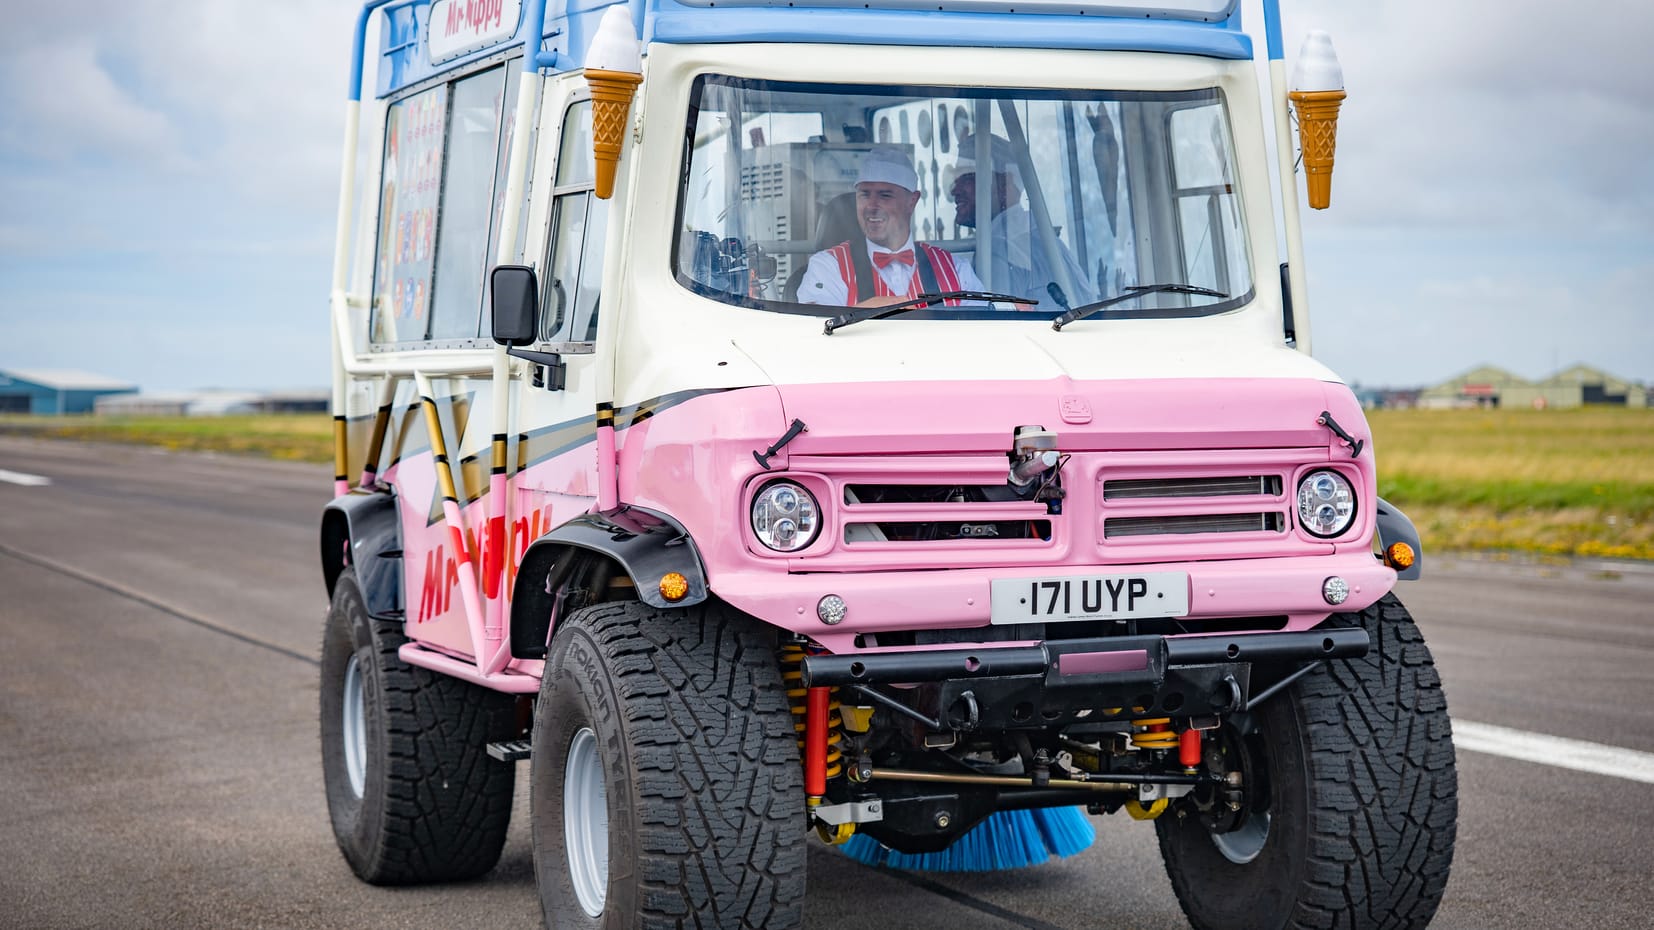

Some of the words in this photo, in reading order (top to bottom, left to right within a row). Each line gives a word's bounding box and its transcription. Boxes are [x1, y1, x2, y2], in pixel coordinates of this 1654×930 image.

[445, 0, 464, 37] Mr
[464, 0, 503, 35] Nippy
[1031, 580, 1070, 615] 171
[1082, 578, 1147, 613] UYP
